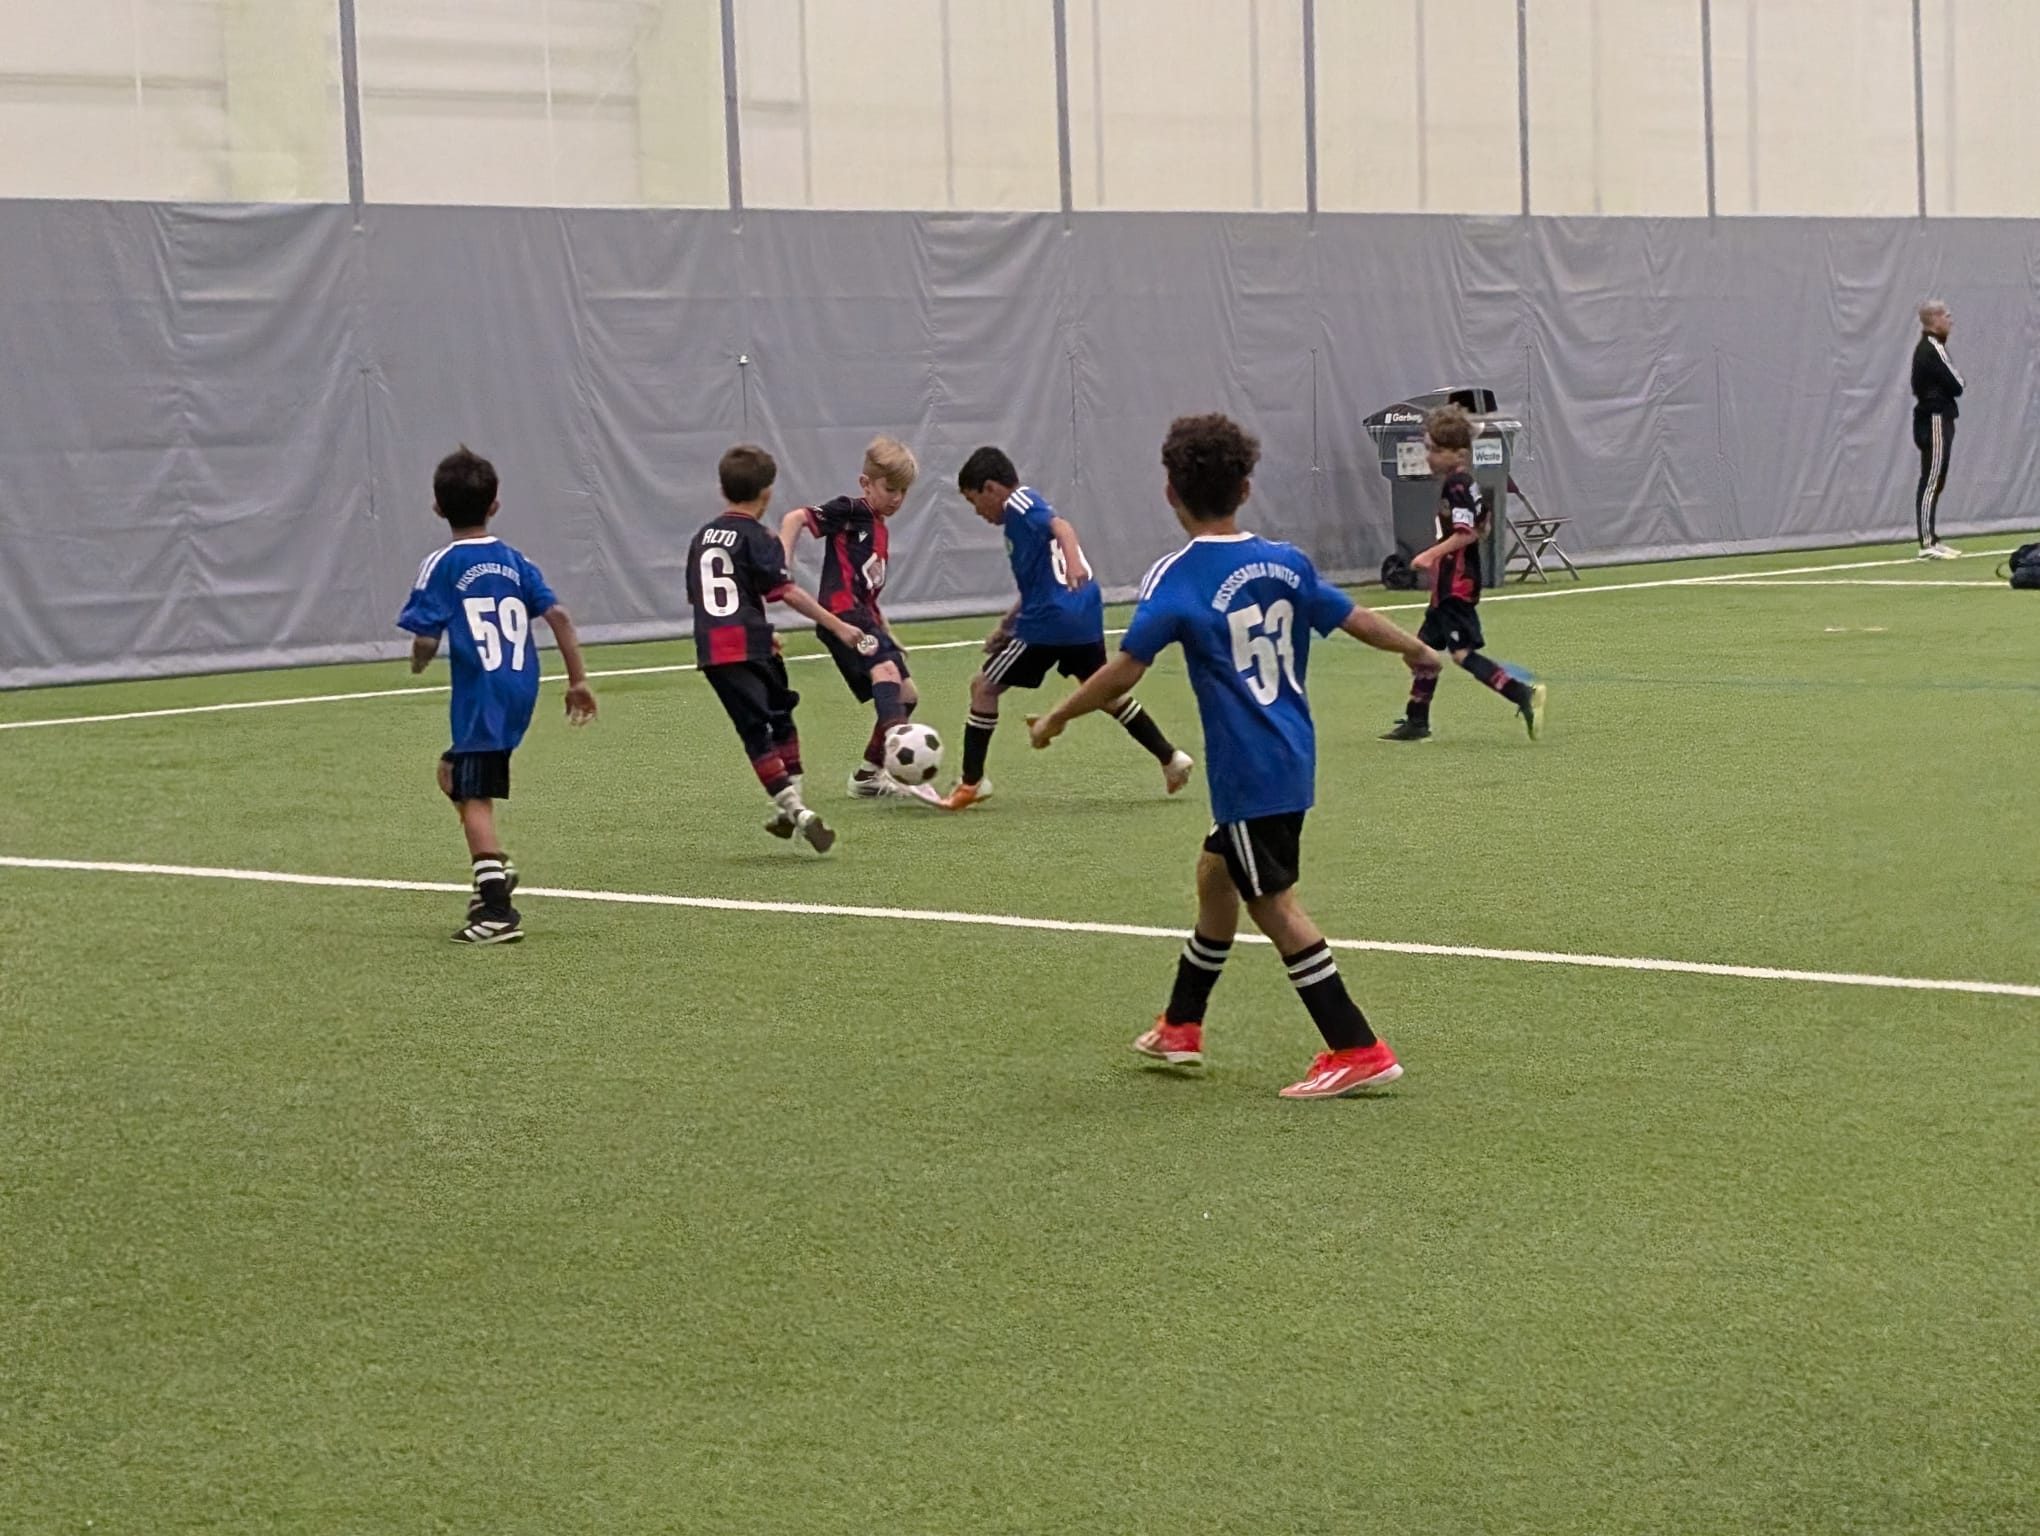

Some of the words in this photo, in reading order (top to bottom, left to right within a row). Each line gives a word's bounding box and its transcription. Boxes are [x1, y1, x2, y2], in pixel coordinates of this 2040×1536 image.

[702, 528, 737, 547] ALTO
[700, 547, 739, 617] 6
[1266, 561, 1301, 590] UNITED
[462, 596, 528, 672] 59
